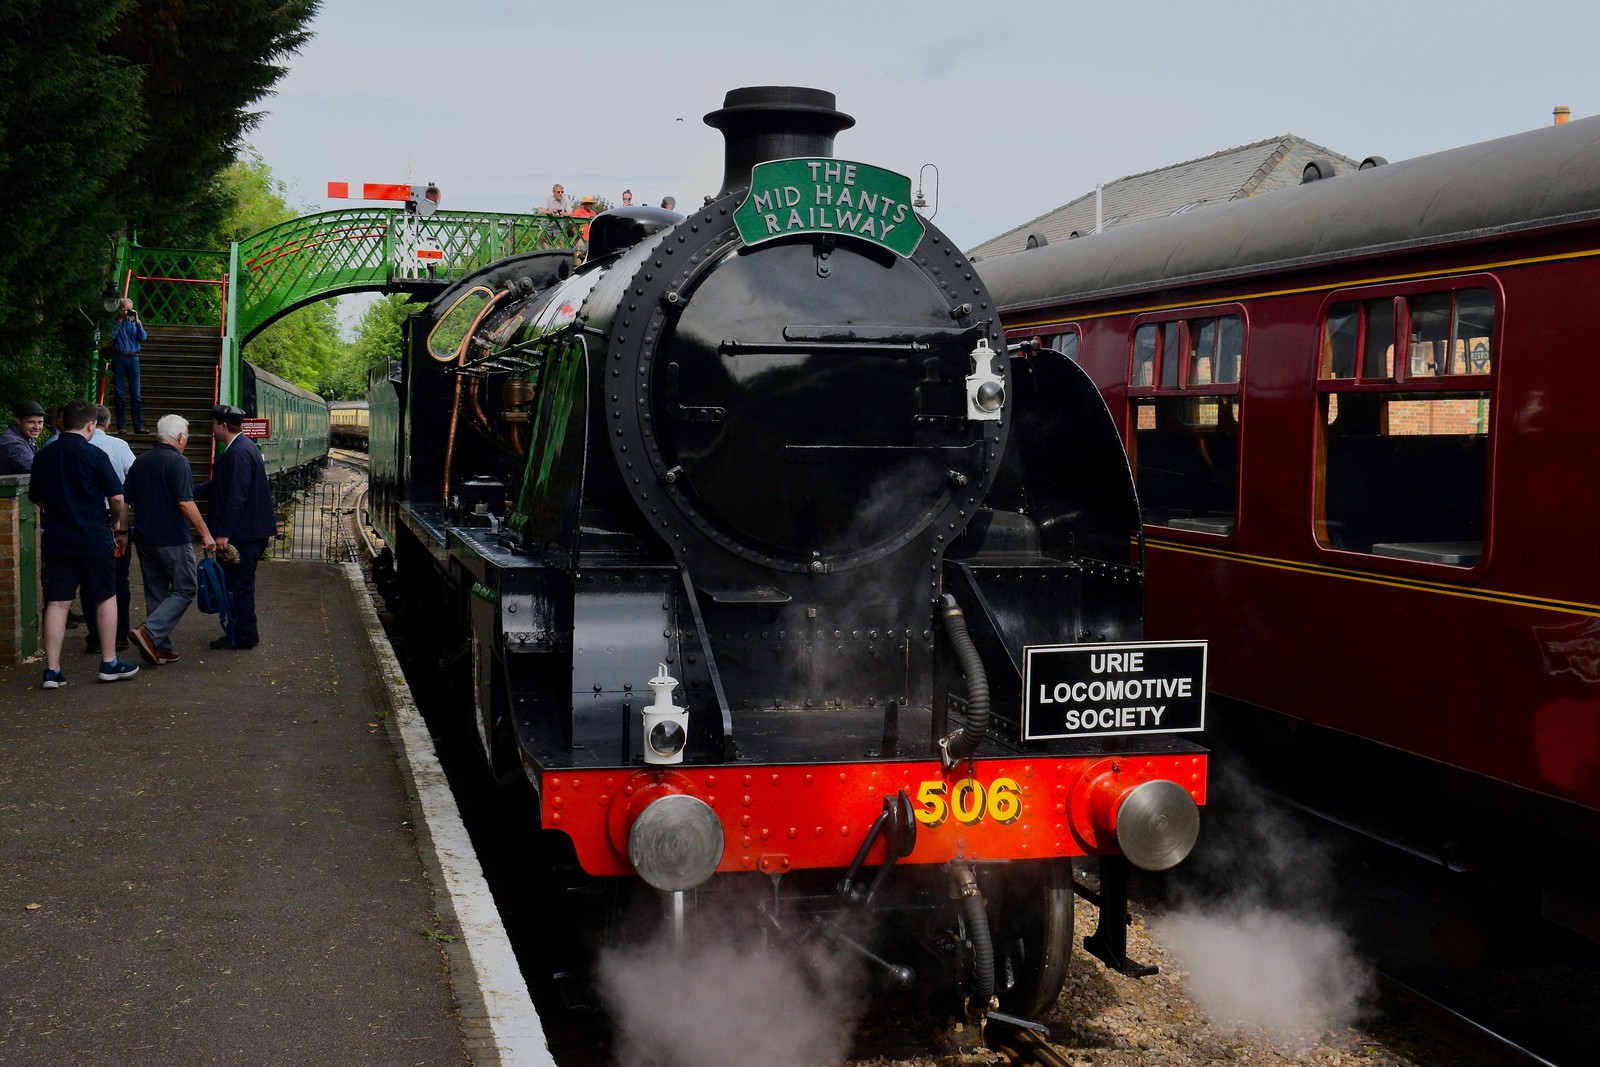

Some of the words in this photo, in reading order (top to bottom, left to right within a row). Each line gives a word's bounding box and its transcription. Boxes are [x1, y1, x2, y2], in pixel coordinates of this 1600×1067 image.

[807, 161, 857, 186] THE
[752, 186, 801, 214] MID
[815, 184, 908, 224] HANTS
[764, 207, 895, 241] RAILWAY
[1090, 652, 1144, 674] URIE
[1040, 677, 1192, 704] LOCOMOTIVE
[1065, 705, 1166, 730] SOCIETY
[914, 777, 1022, 828] 506
